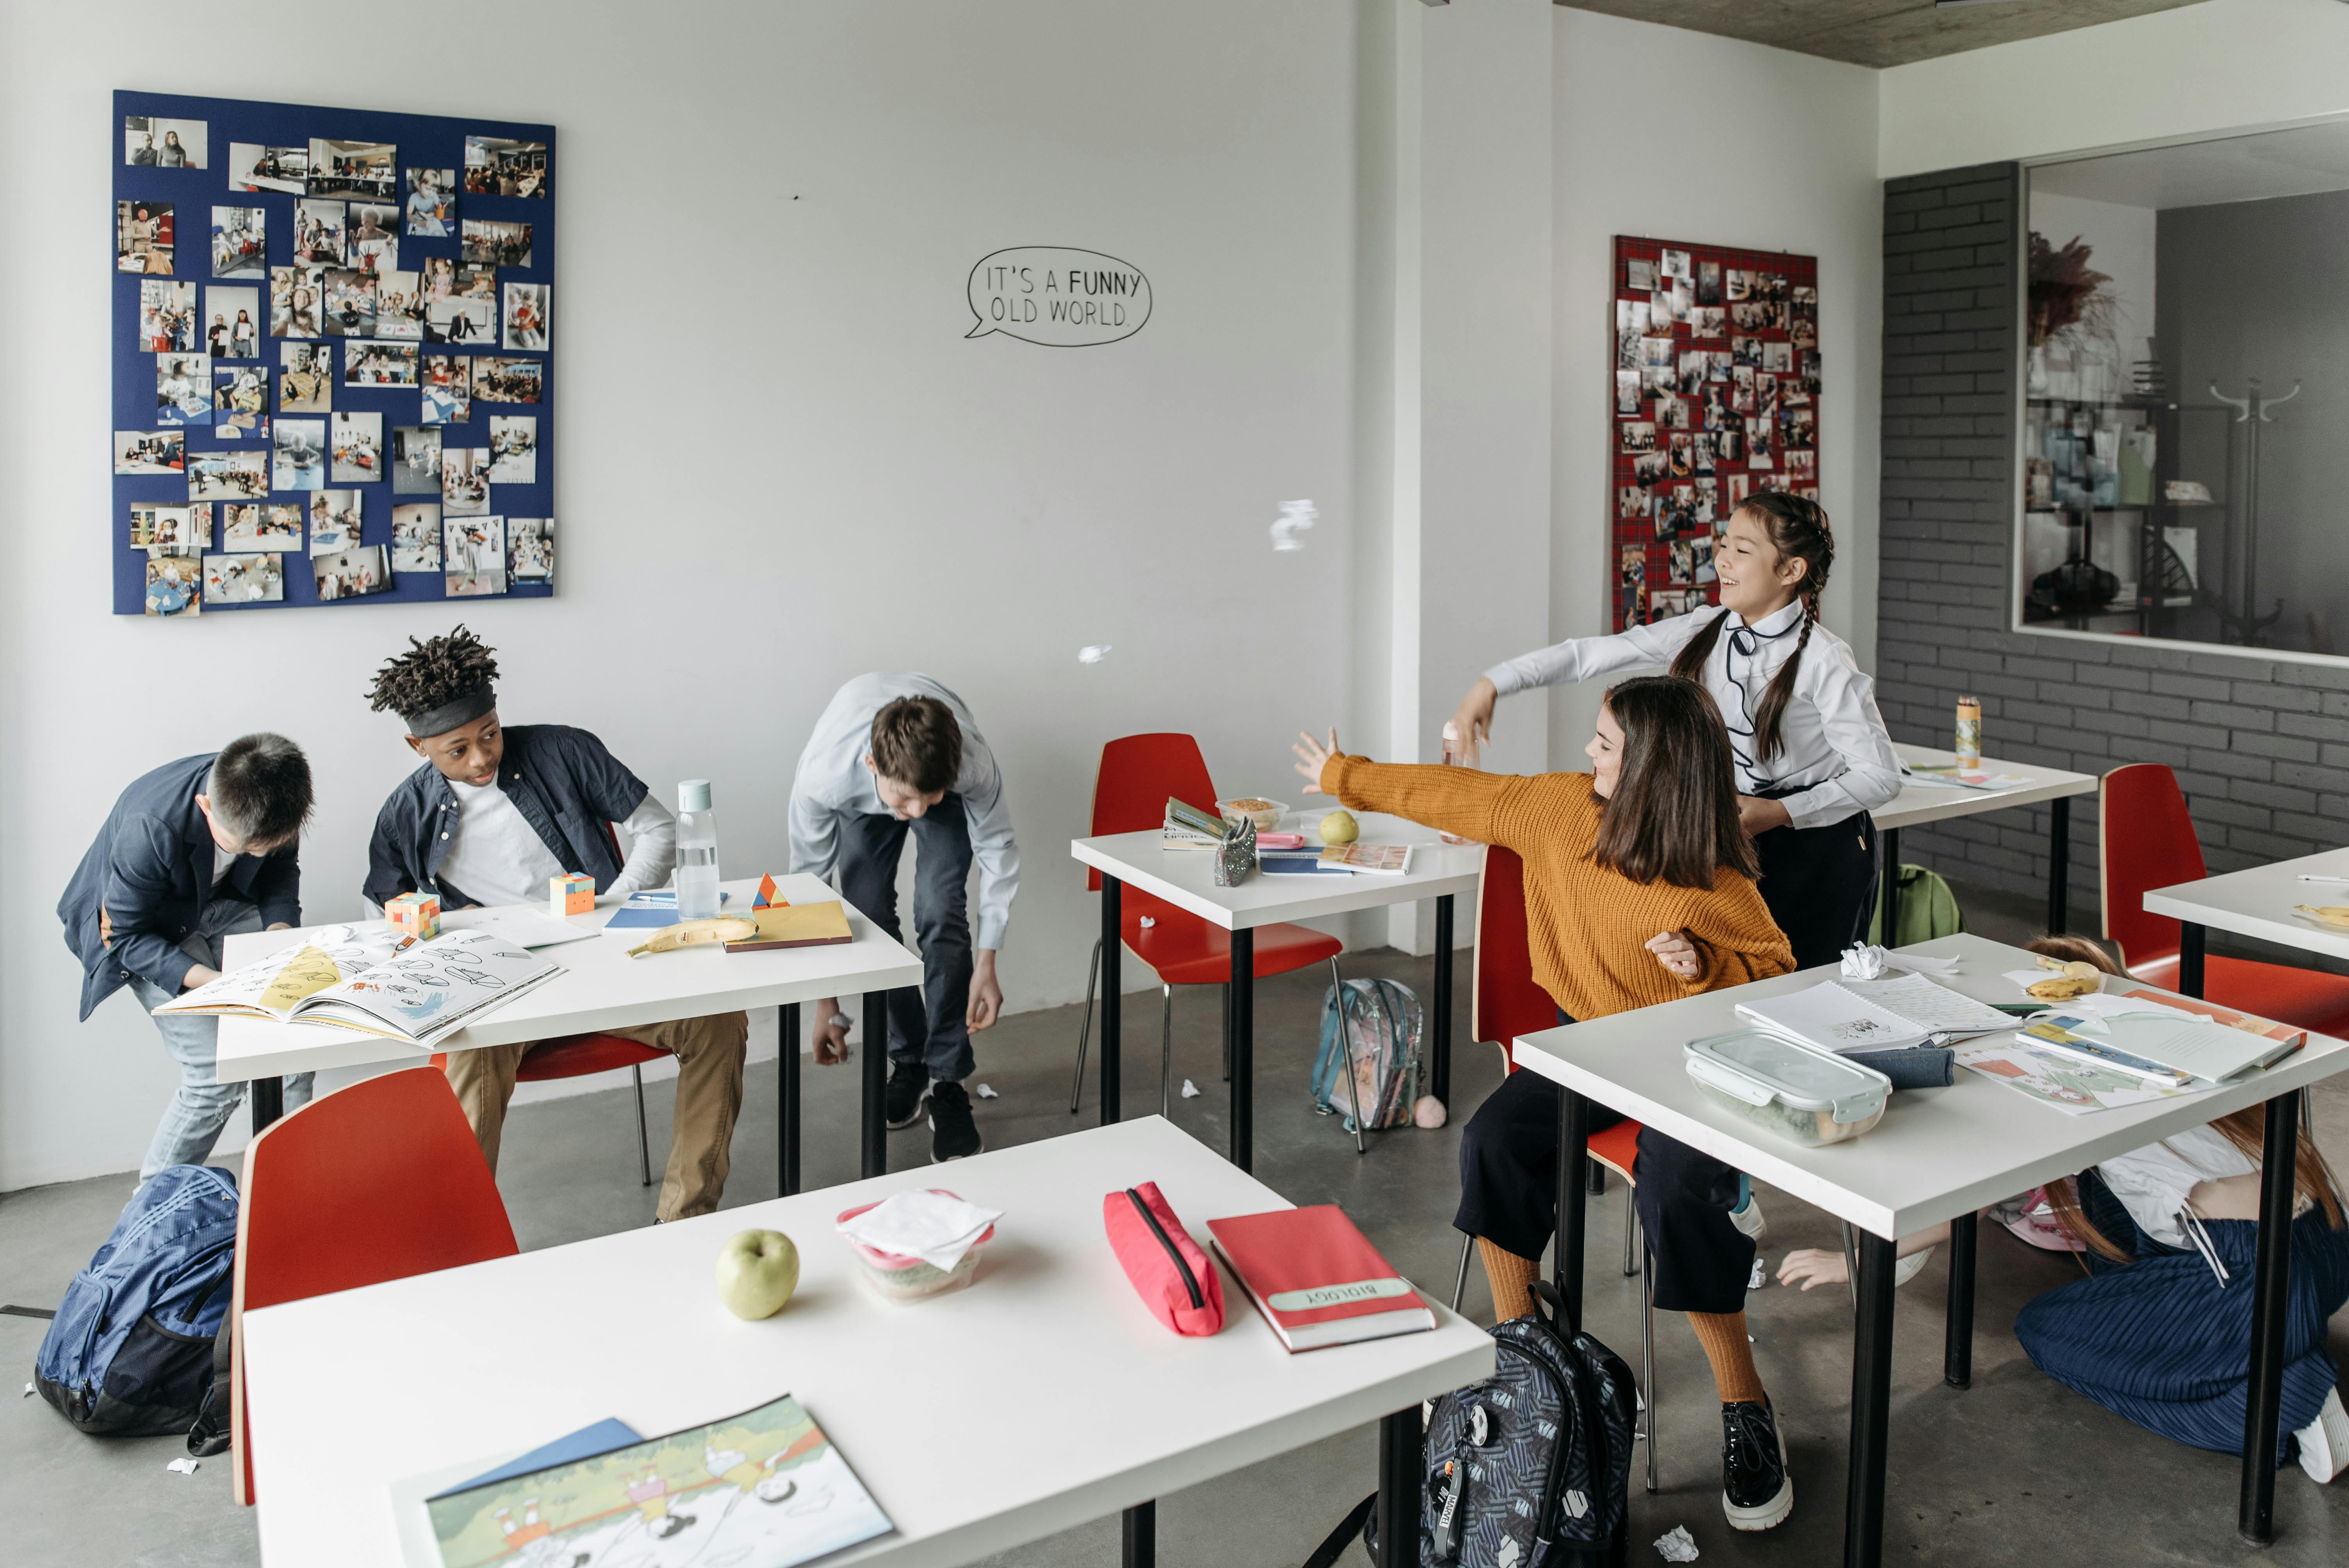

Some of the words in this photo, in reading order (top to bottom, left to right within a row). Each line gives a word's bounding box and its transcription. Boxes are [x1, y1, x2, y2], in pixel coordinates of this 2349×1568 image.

[987, 266, 1034, 293] IT'S
[1046, 270, 1058, 293] A
[1069, 271, 1141, 298] FUNNY
[991, 297, 1037, 323] OLD
[1306, 1284, 1377, 1304] BIOLOGY
[1440, 1496, 1456, 1525] MARVEL
